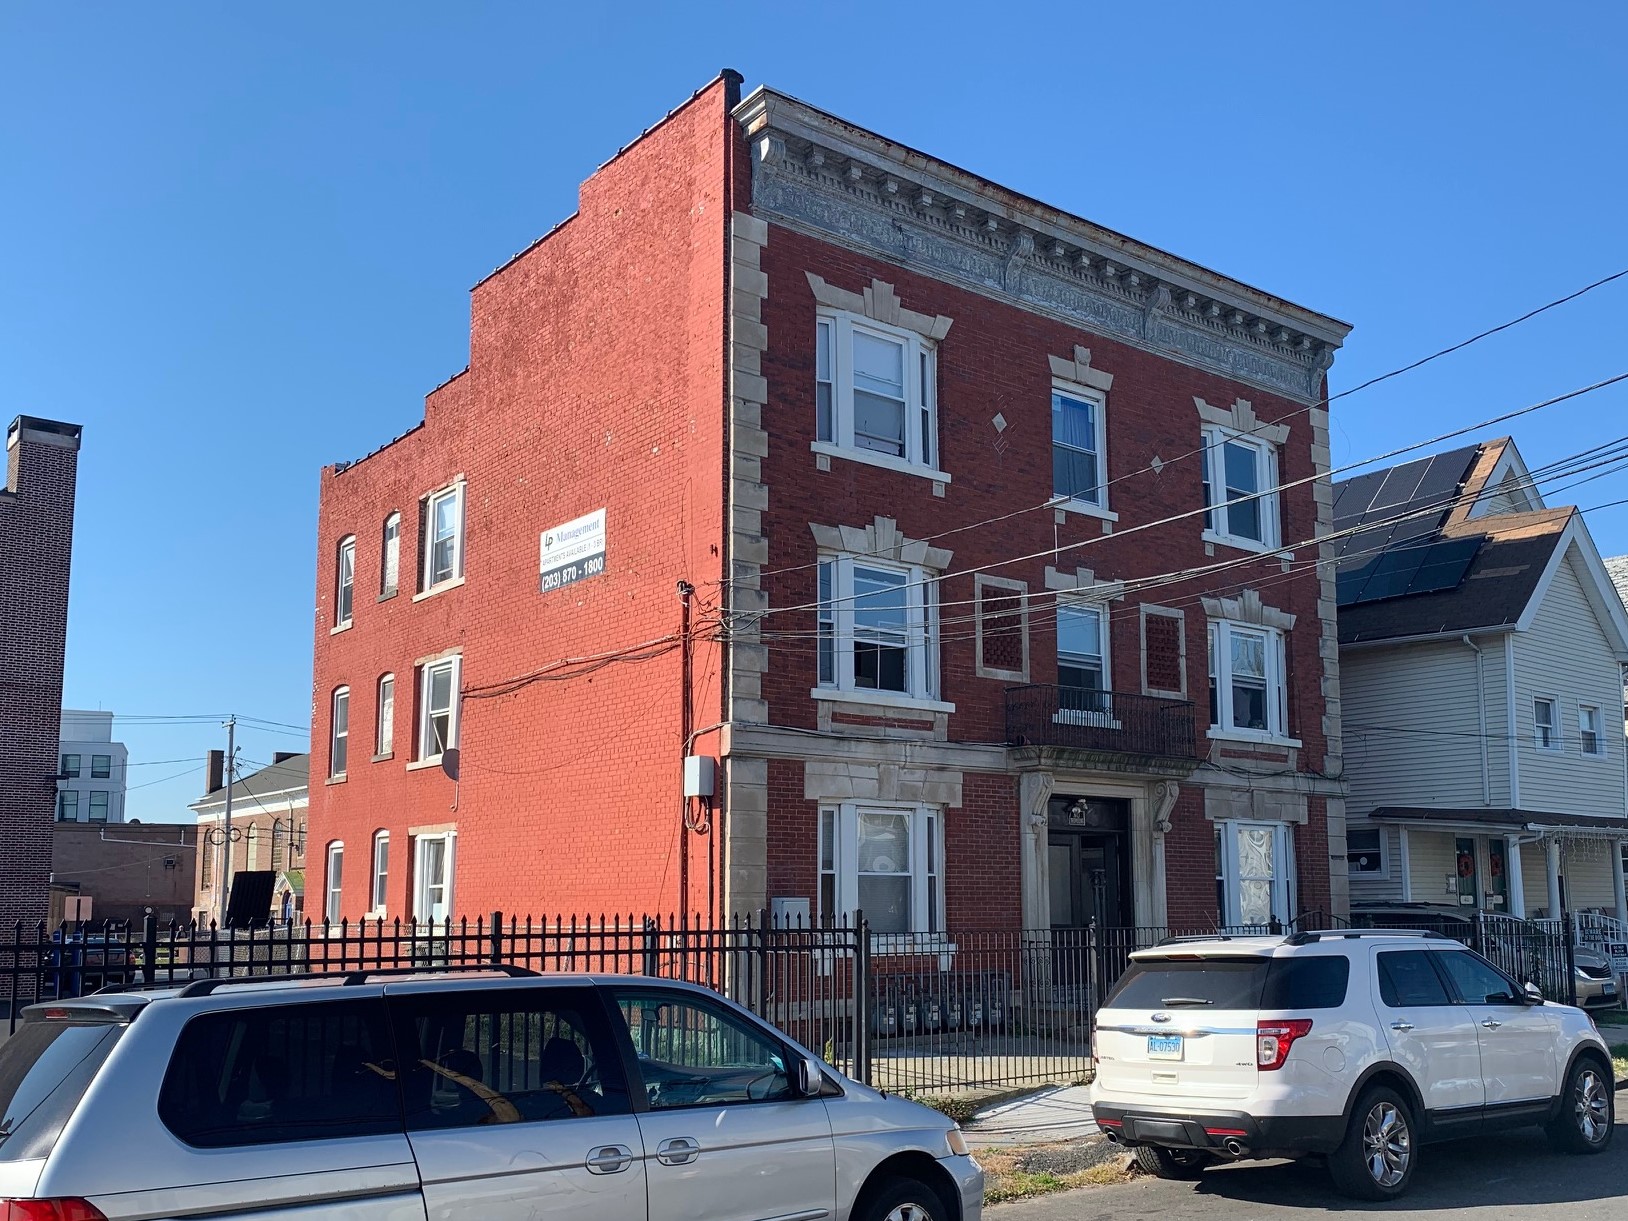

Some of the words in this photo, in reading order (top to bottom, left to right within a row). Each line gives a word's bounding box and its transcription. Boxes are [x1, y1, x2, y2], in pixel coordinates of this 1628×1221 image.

[556, 518, 600, 543] Management
[566, 544, 587, 557] AVAILABLE
[542, 571, 561, 593] (203)
[562, 565, 577, 583] 870
[583, 556, 603, 575] 1800
